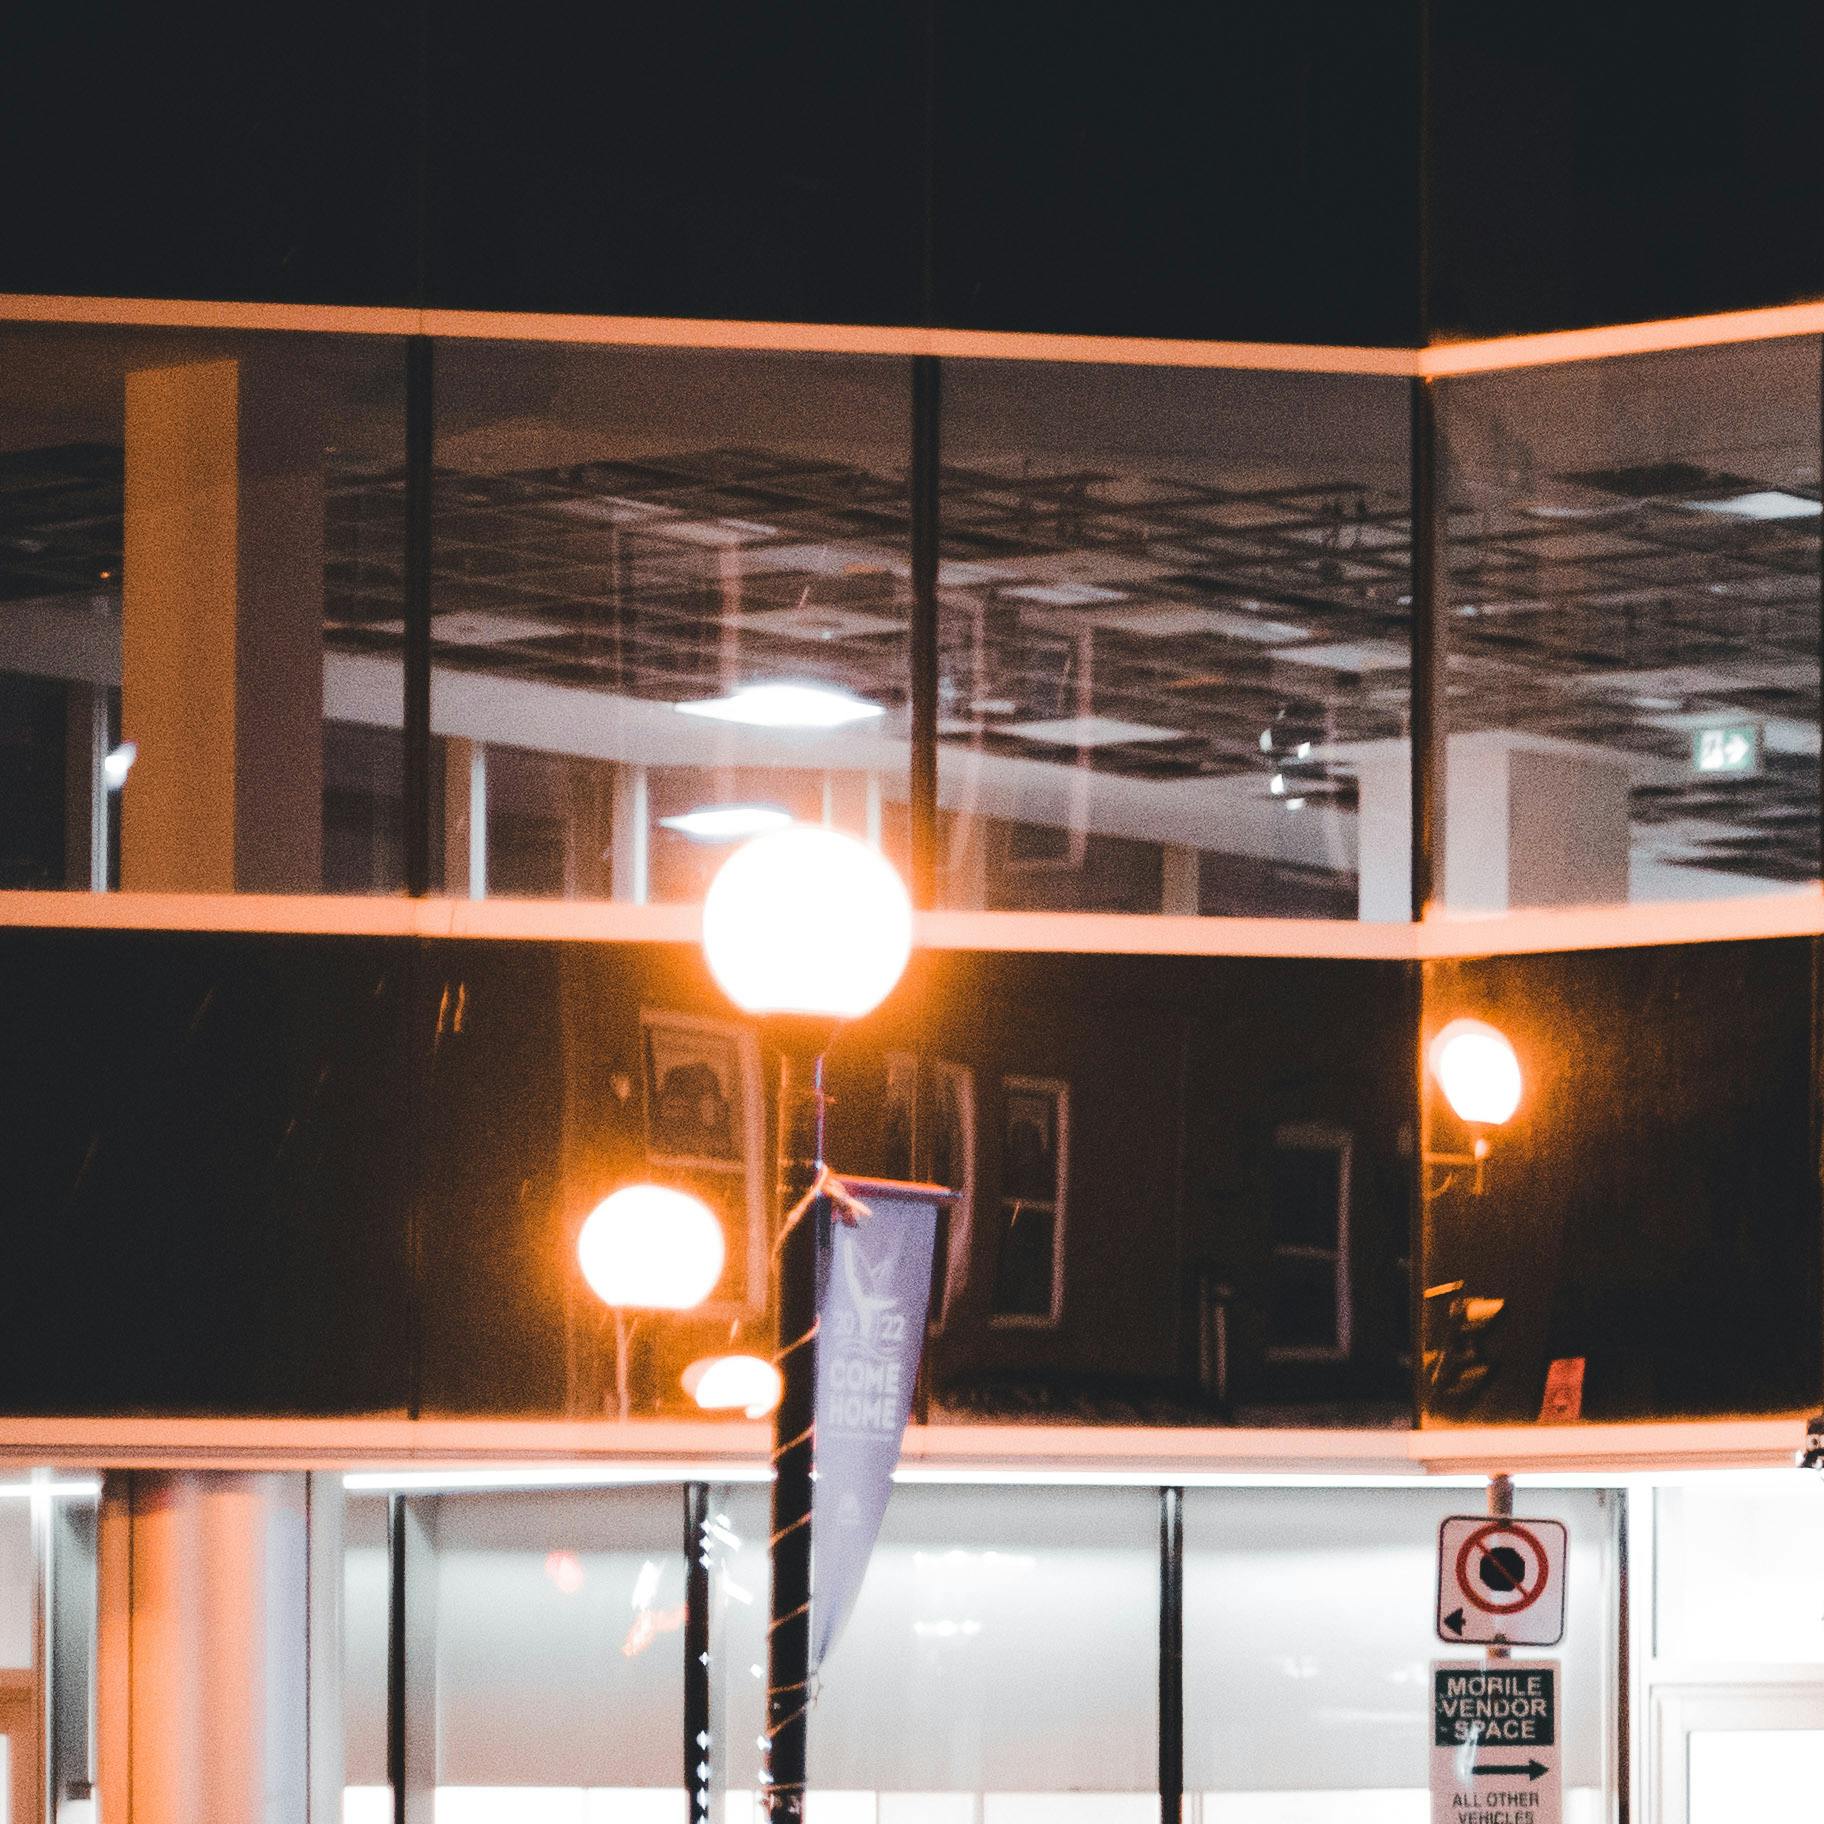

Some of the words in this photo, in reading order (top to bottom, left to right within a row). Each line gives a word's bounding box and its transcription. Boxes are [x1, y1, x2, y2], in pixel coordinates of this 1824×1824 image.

[829, 1359, 901, 1393] COME
[829, 1395, 898, 1429] HOME
[1442, 1698, 1548, 1718] VENDOR
[1454, 1720, 1537, 1740] SPACE
[1452, 1792, 1481, 1808] ALL
[1486, 1791, 1540, 1808] OTHER
